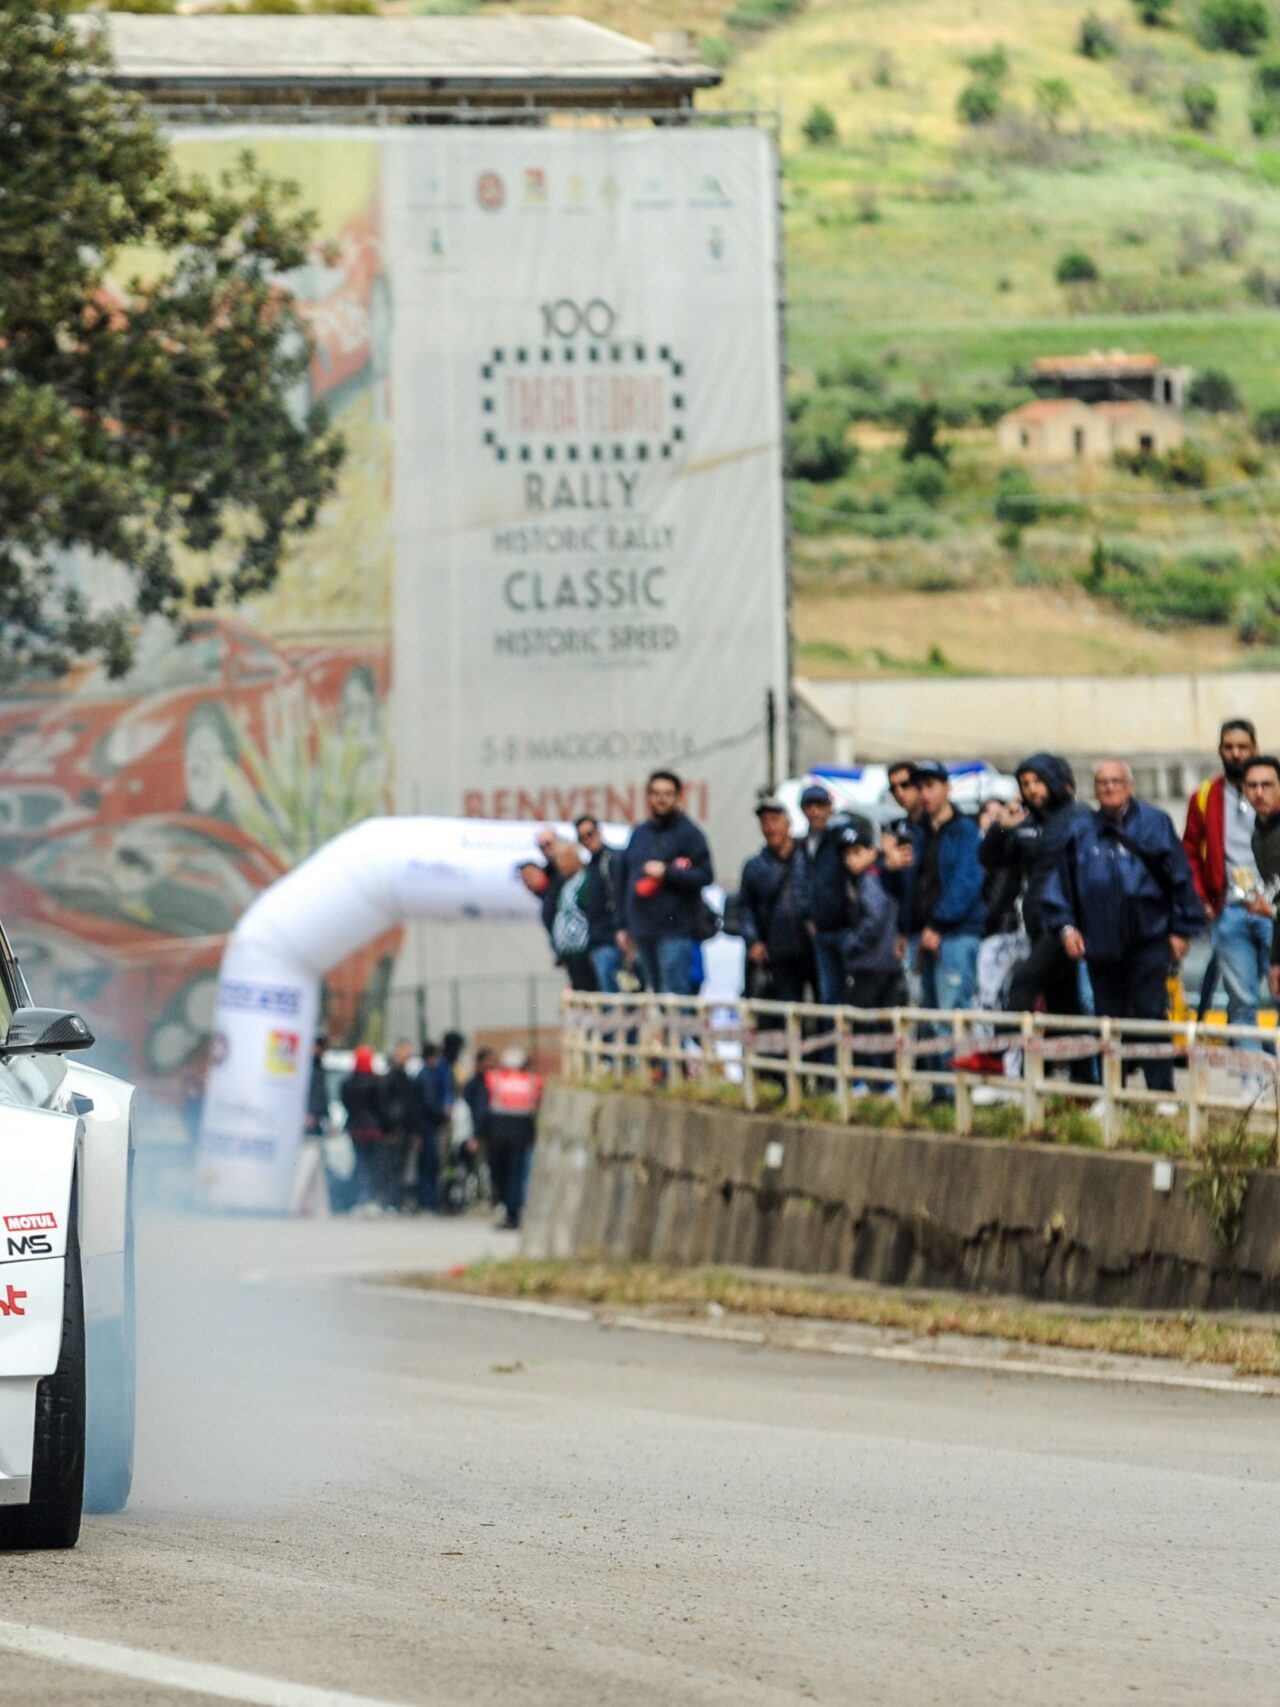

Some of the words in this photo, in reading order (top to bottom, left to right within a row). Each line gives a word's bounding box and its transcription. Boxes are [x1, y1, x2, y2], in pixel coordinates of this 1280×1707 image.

[540, 298, 616, 339] 100
[525, 471, 640, 510] RALLY
[493, 525, 597, 555] HISTORIC
[606, 523, 675, 553] RALLY
[503, 567, 667, 612] CLASSIC
[493, 626, 598, 656] HISTORIC
[607, 624, 680, 652] SPEED
[527, 731, 626, 762] MAGGIO
[7, 1215, 56, 1230] MOTUL
[7, 1235, 52, 1256] MS
